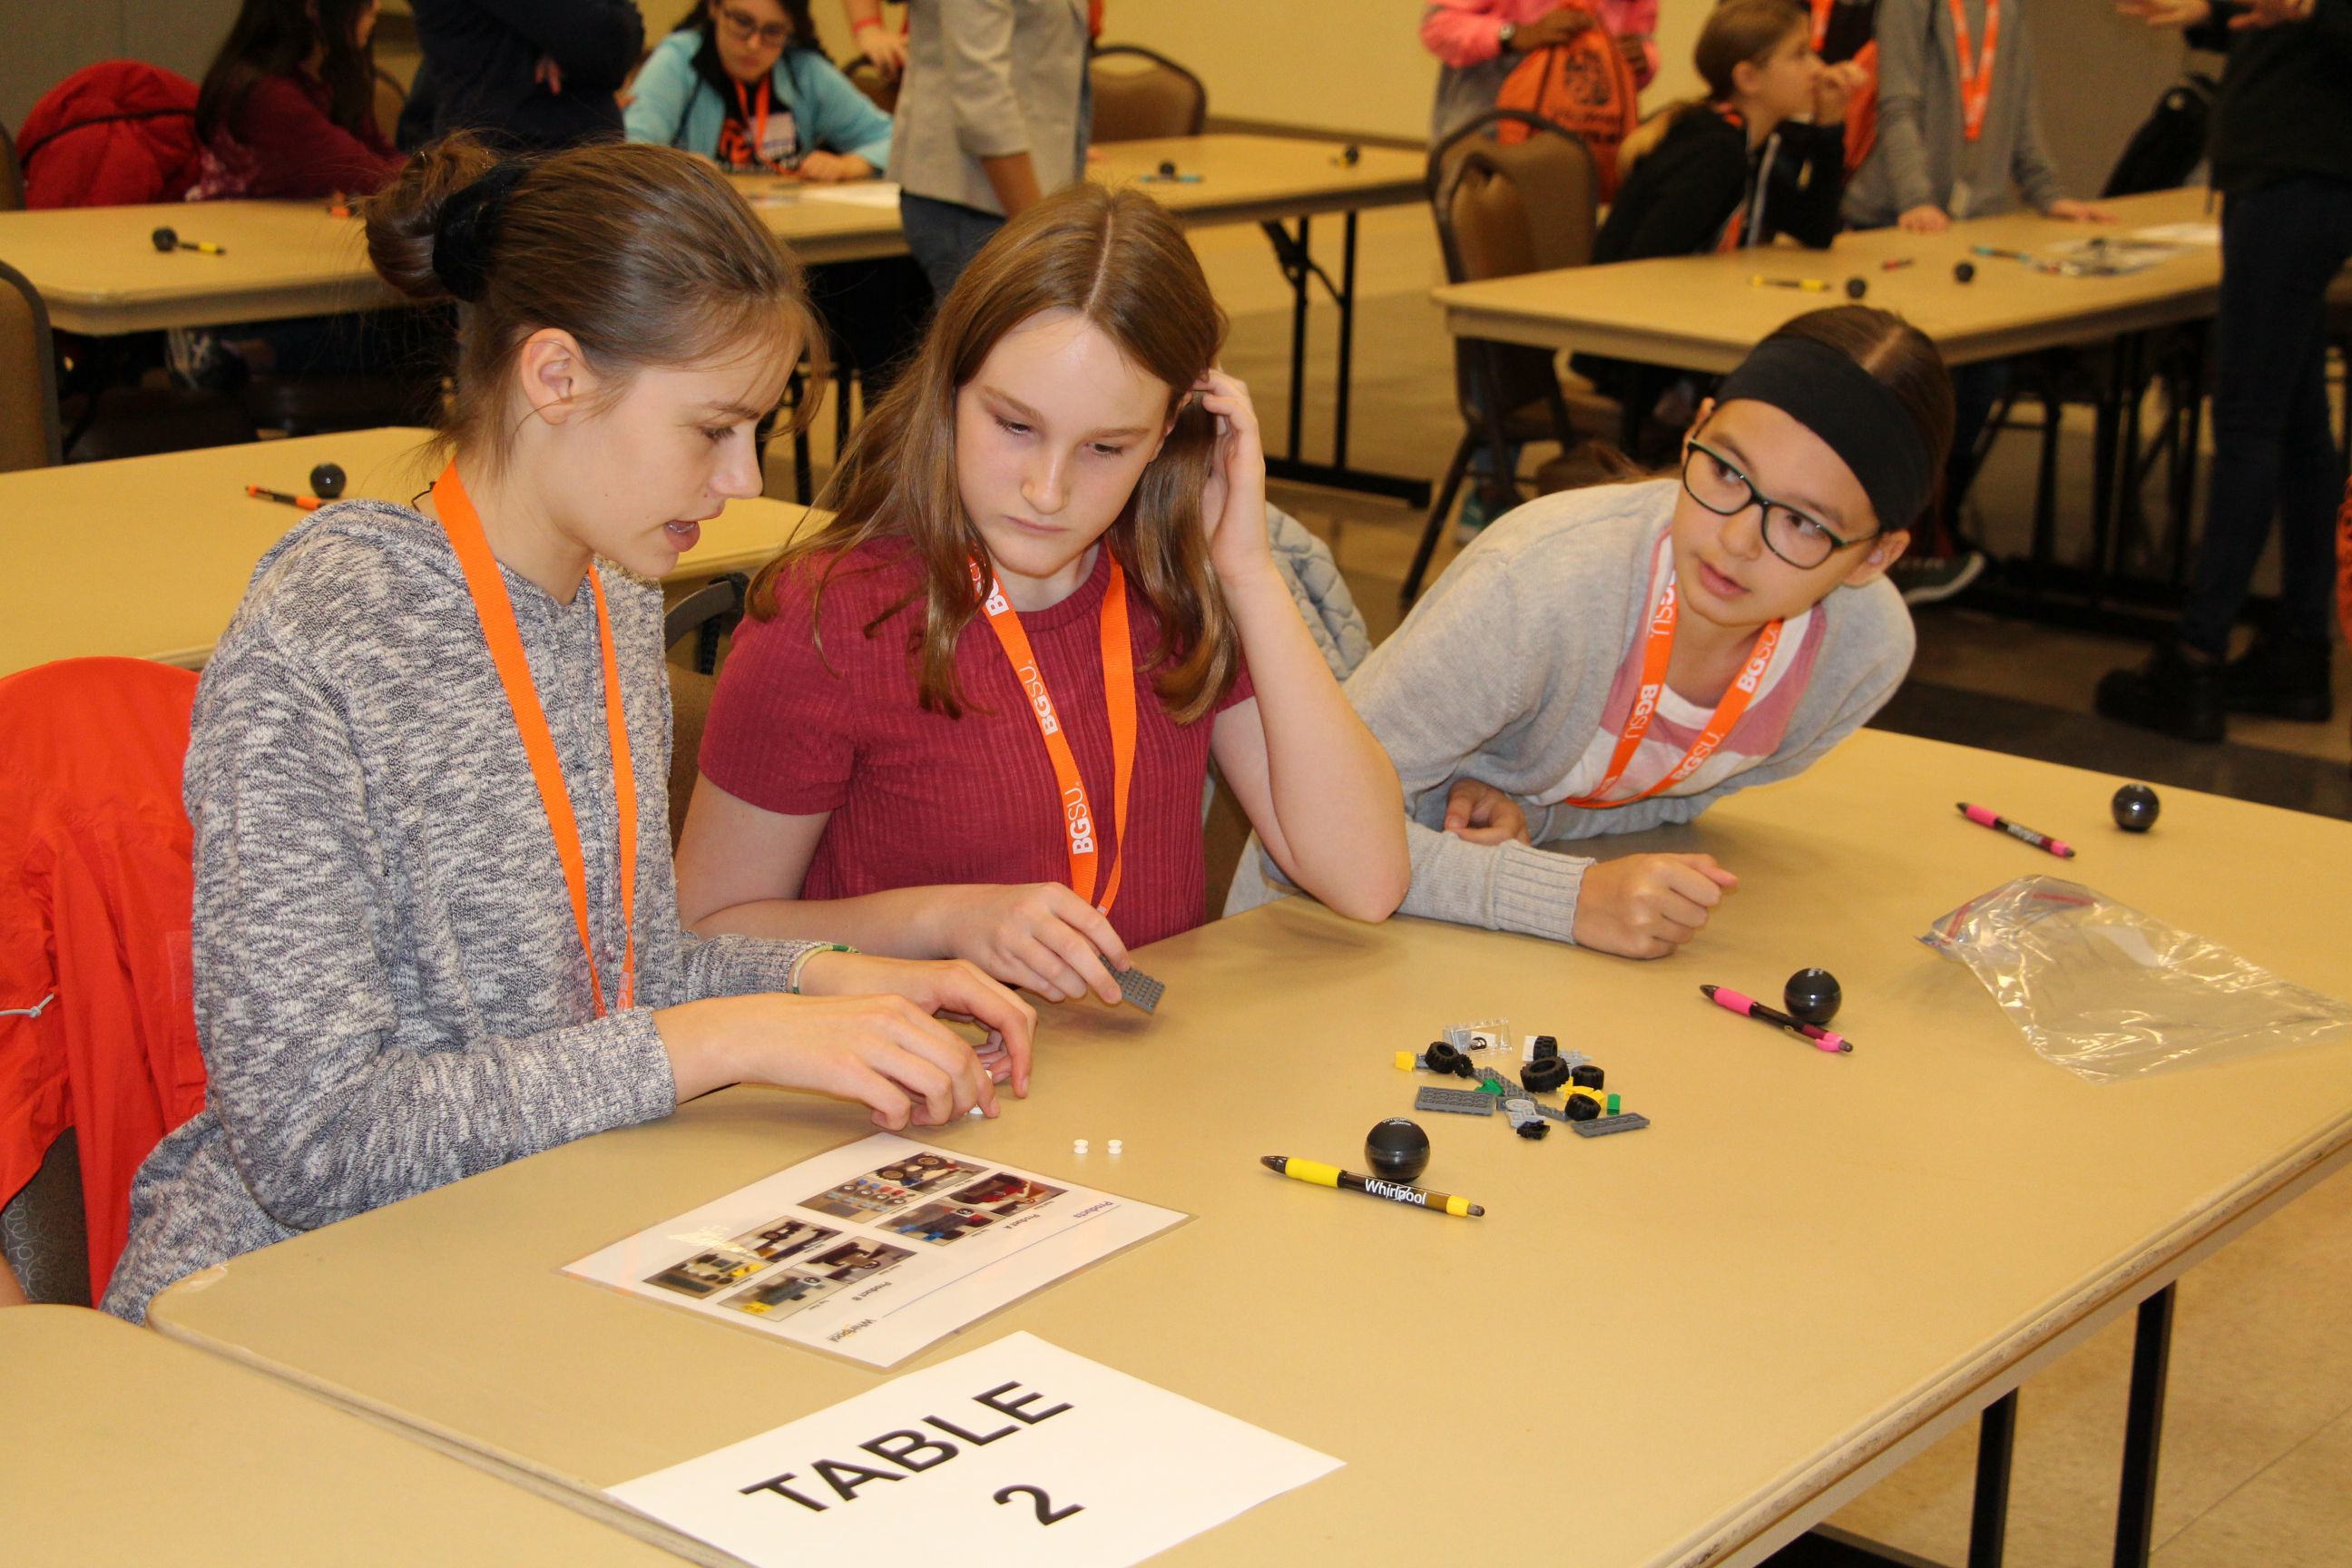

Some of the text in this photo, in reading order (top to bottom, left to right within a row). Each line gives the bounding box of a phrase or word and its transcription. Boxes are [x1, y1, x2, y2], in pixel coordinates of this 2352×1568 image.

[1735, 626, 1779, 694] BGSU
[1018, 663, 1059, 735] BGSU
[1624, 683, 1660, 740] BGSU
[1064, 784, 1094, 855] BGSU
[1073, 1200, 1114, 1219] Products
[1365, 1178, 1426, 1206] Whirlpool
[739, 1380, 1075, 1513] TABLE
[993, 1484, 1085, 1526] 2
